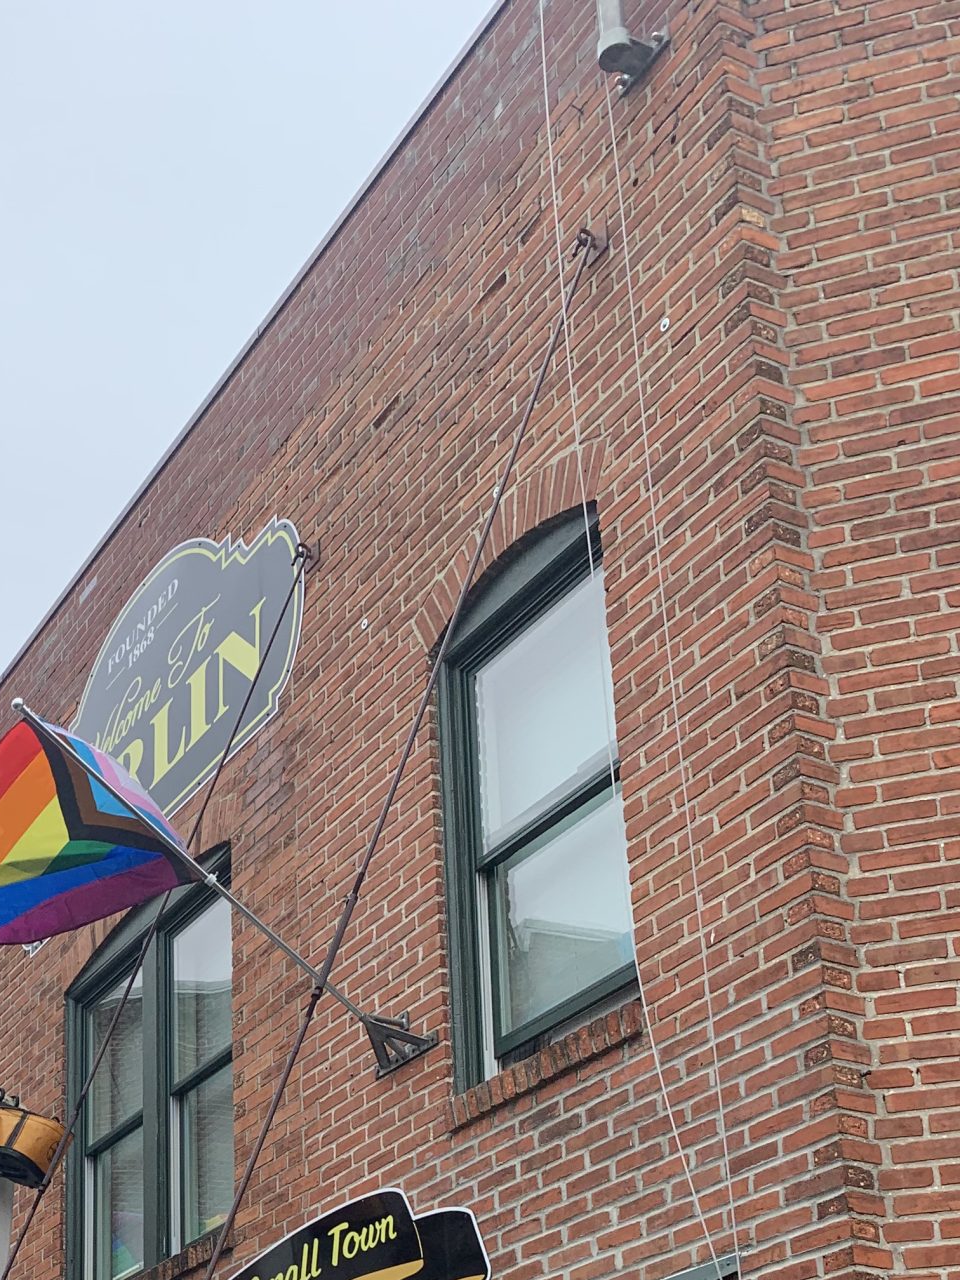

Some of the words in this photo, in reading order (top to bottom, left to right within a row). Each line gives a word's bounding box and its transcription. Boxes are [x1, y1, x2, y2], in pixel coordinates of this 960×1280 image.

[107, 578, 179, 675] FOUNDED
[127, 625, 156, 669] 1868
[116, 597, 267, 792] RLIN
[327, 1214, 397, 1268] Town
